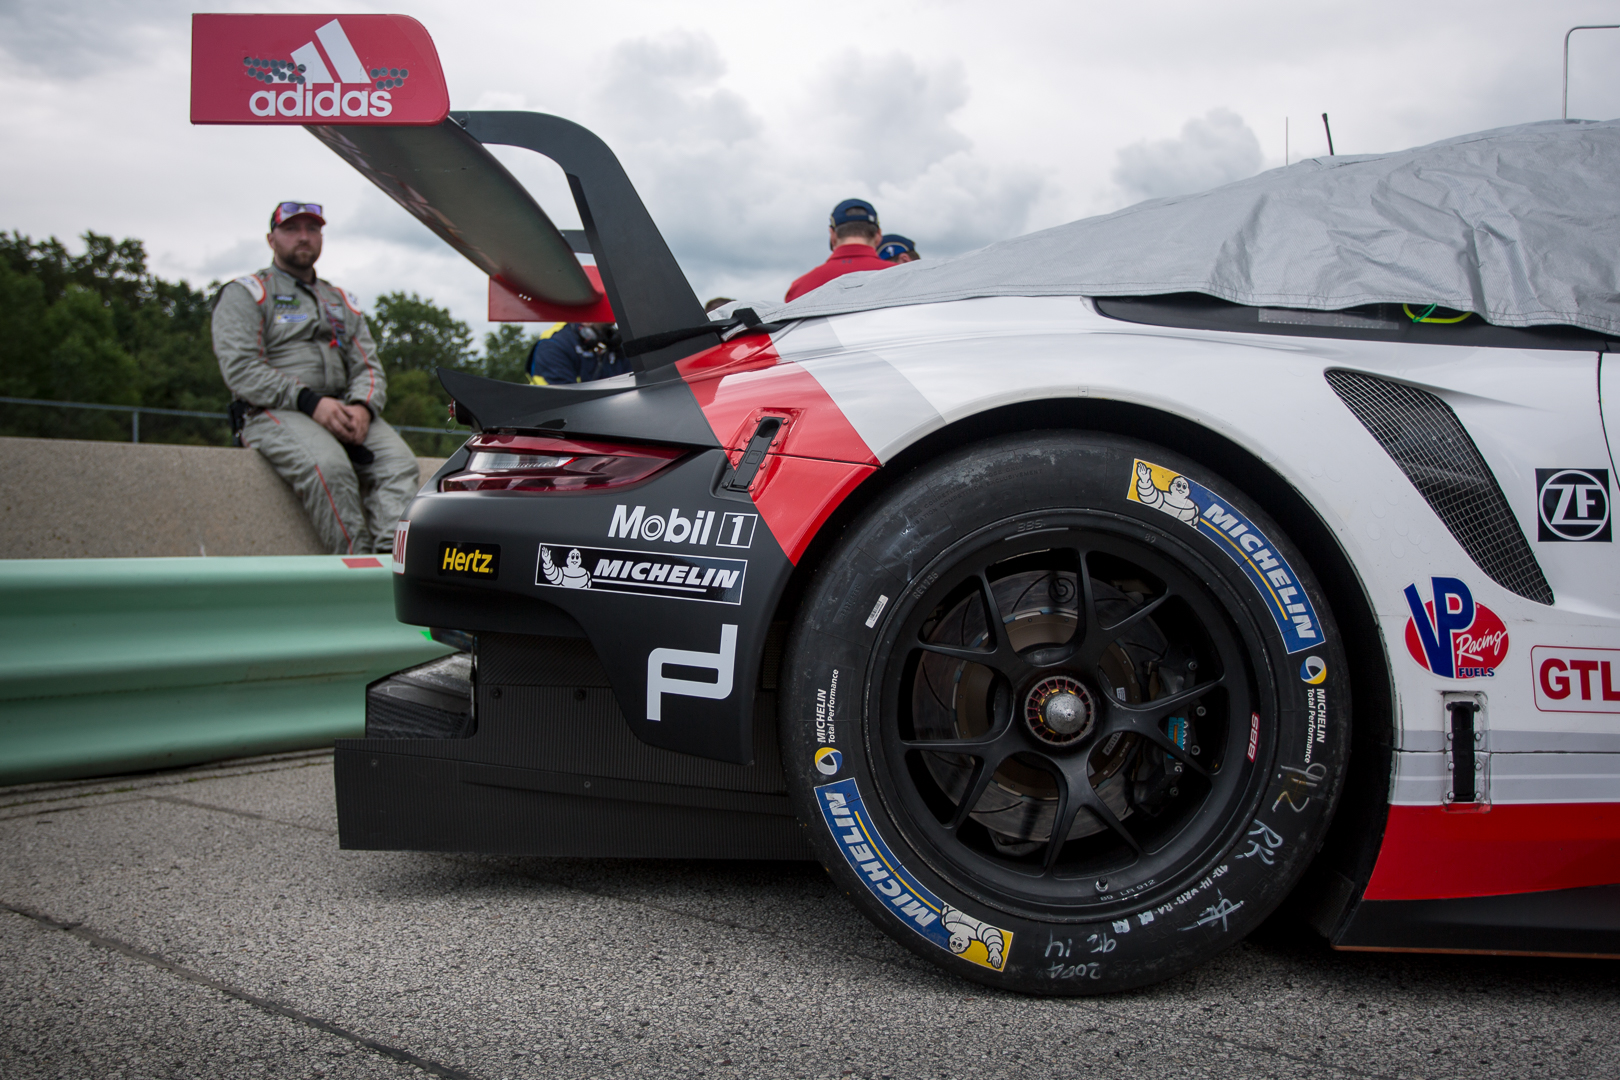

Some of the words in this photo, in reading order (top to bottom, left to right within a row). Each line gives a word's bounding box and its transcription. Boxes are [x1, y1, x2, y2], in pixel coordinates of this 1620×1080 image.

[249, 82, 393, 117] adidas
[608, 505, 715, 546] Mobil
[1545, 483, 1605, 526] ZF
[442, 547, 494, 574] Hertz
[593, 558, 740, 589] MICHELIN
[1203, 503, 1316, 639] MICHELIN
[1404, 576, 1476, 679] VP
[1456, 628, 1509, 666] Racing
[828, 669, 839, 720] Performance
[1458, 667, 1495, 678] FUELS
[1539, 657, 1620, 702] GTL
[816, 688, 827, 743] MICHELIN
[1307, 688, 1316, 709] Total
[1316, 688, 1326, 743] MICHELIN
[827, 721, 836, 744] Total
[1247, 713, 1260, 761] BBS
[1304, 710, 1315, 764] Performance
[825, 792, 938, 928] MICHELIN
